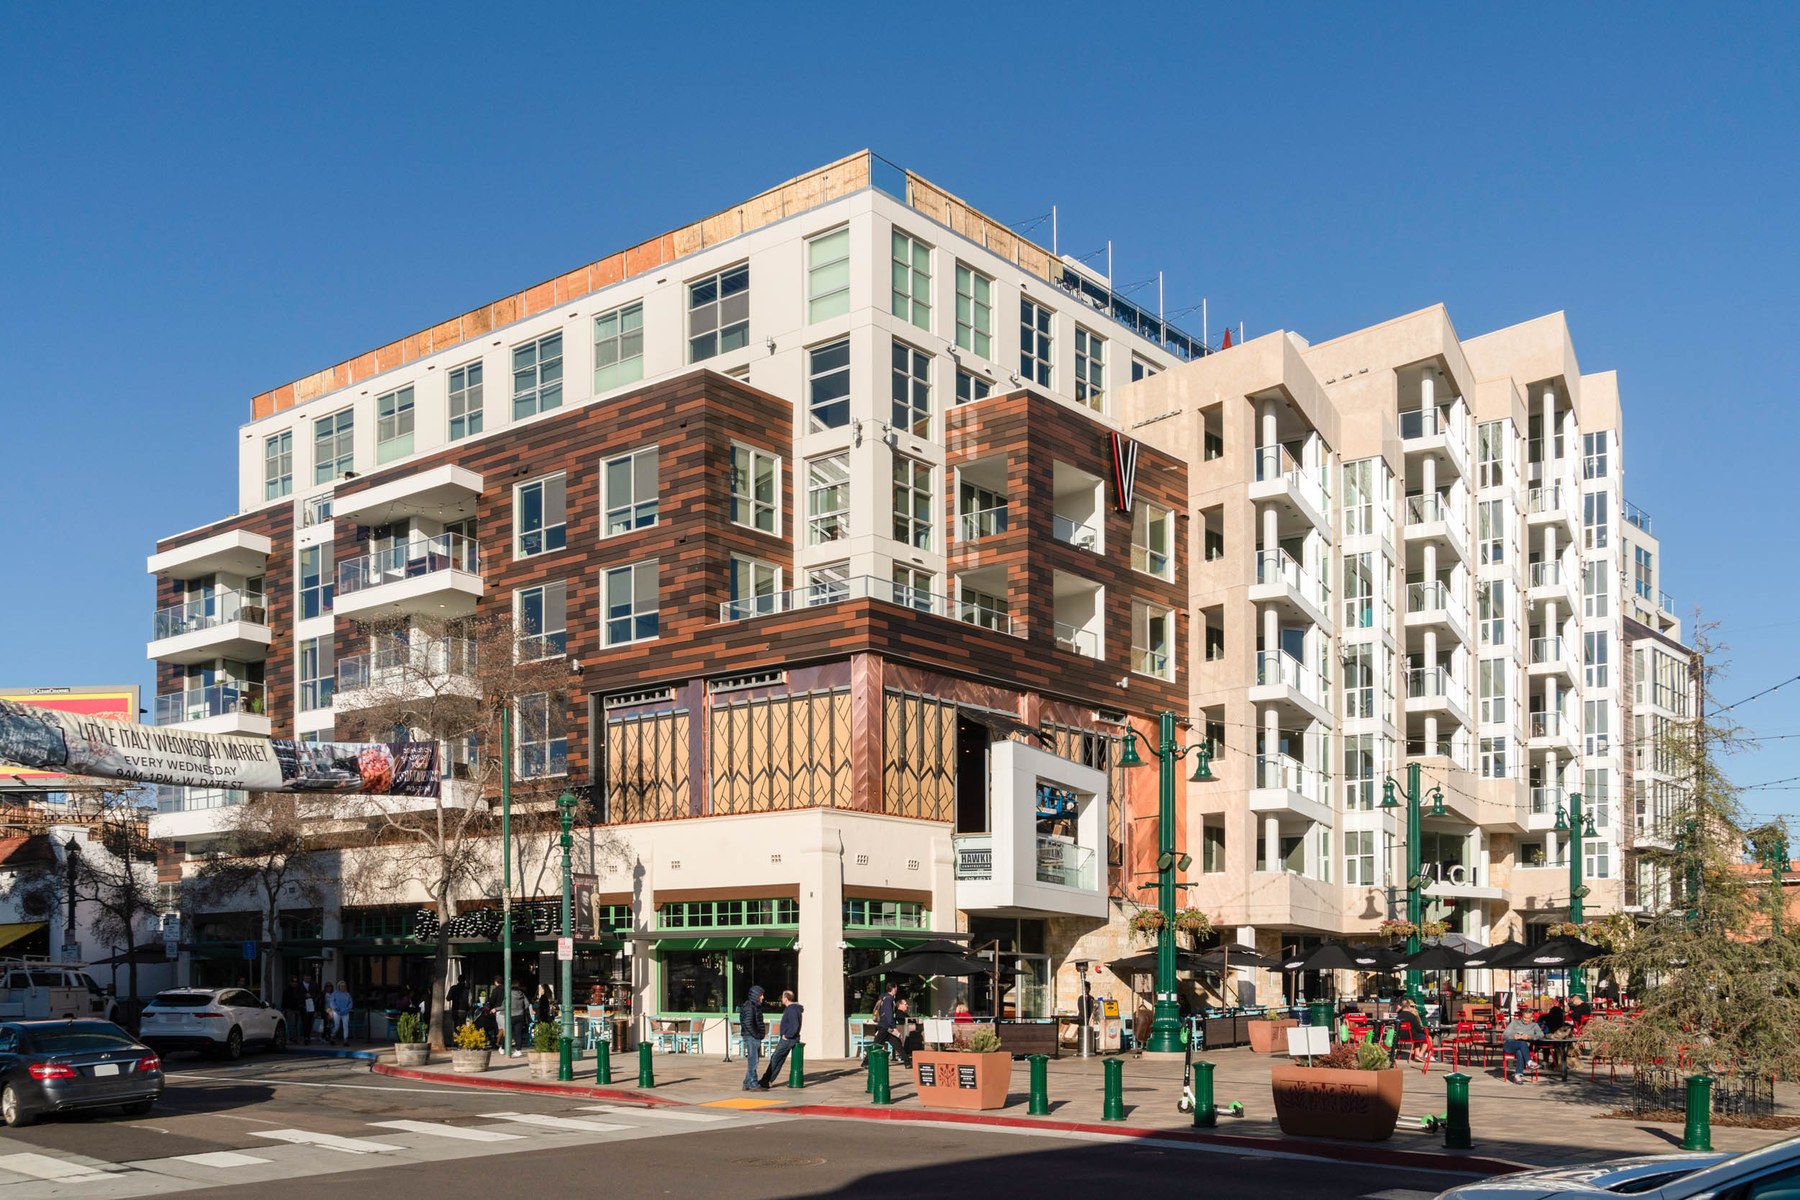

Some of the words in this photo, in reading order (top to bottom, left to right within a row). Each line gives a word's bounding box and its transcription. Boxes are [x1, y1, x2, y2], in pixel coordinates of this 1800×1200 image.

[77, 721, 117, 748] LITTLE
[118, 728, 151, 750] ITALY
[153, 733, 221, 760] WEDNESDAY
[222, 742, 269, 762] MARKET
[124, 755, 164, 769] EVERY
[166, 759, 237, 777] WEDNESDAY
[116, 768, 174, 784] 9AM-1PM
[200, 778, 228, 789] DATE
[230, 781, 244, 790] ST
